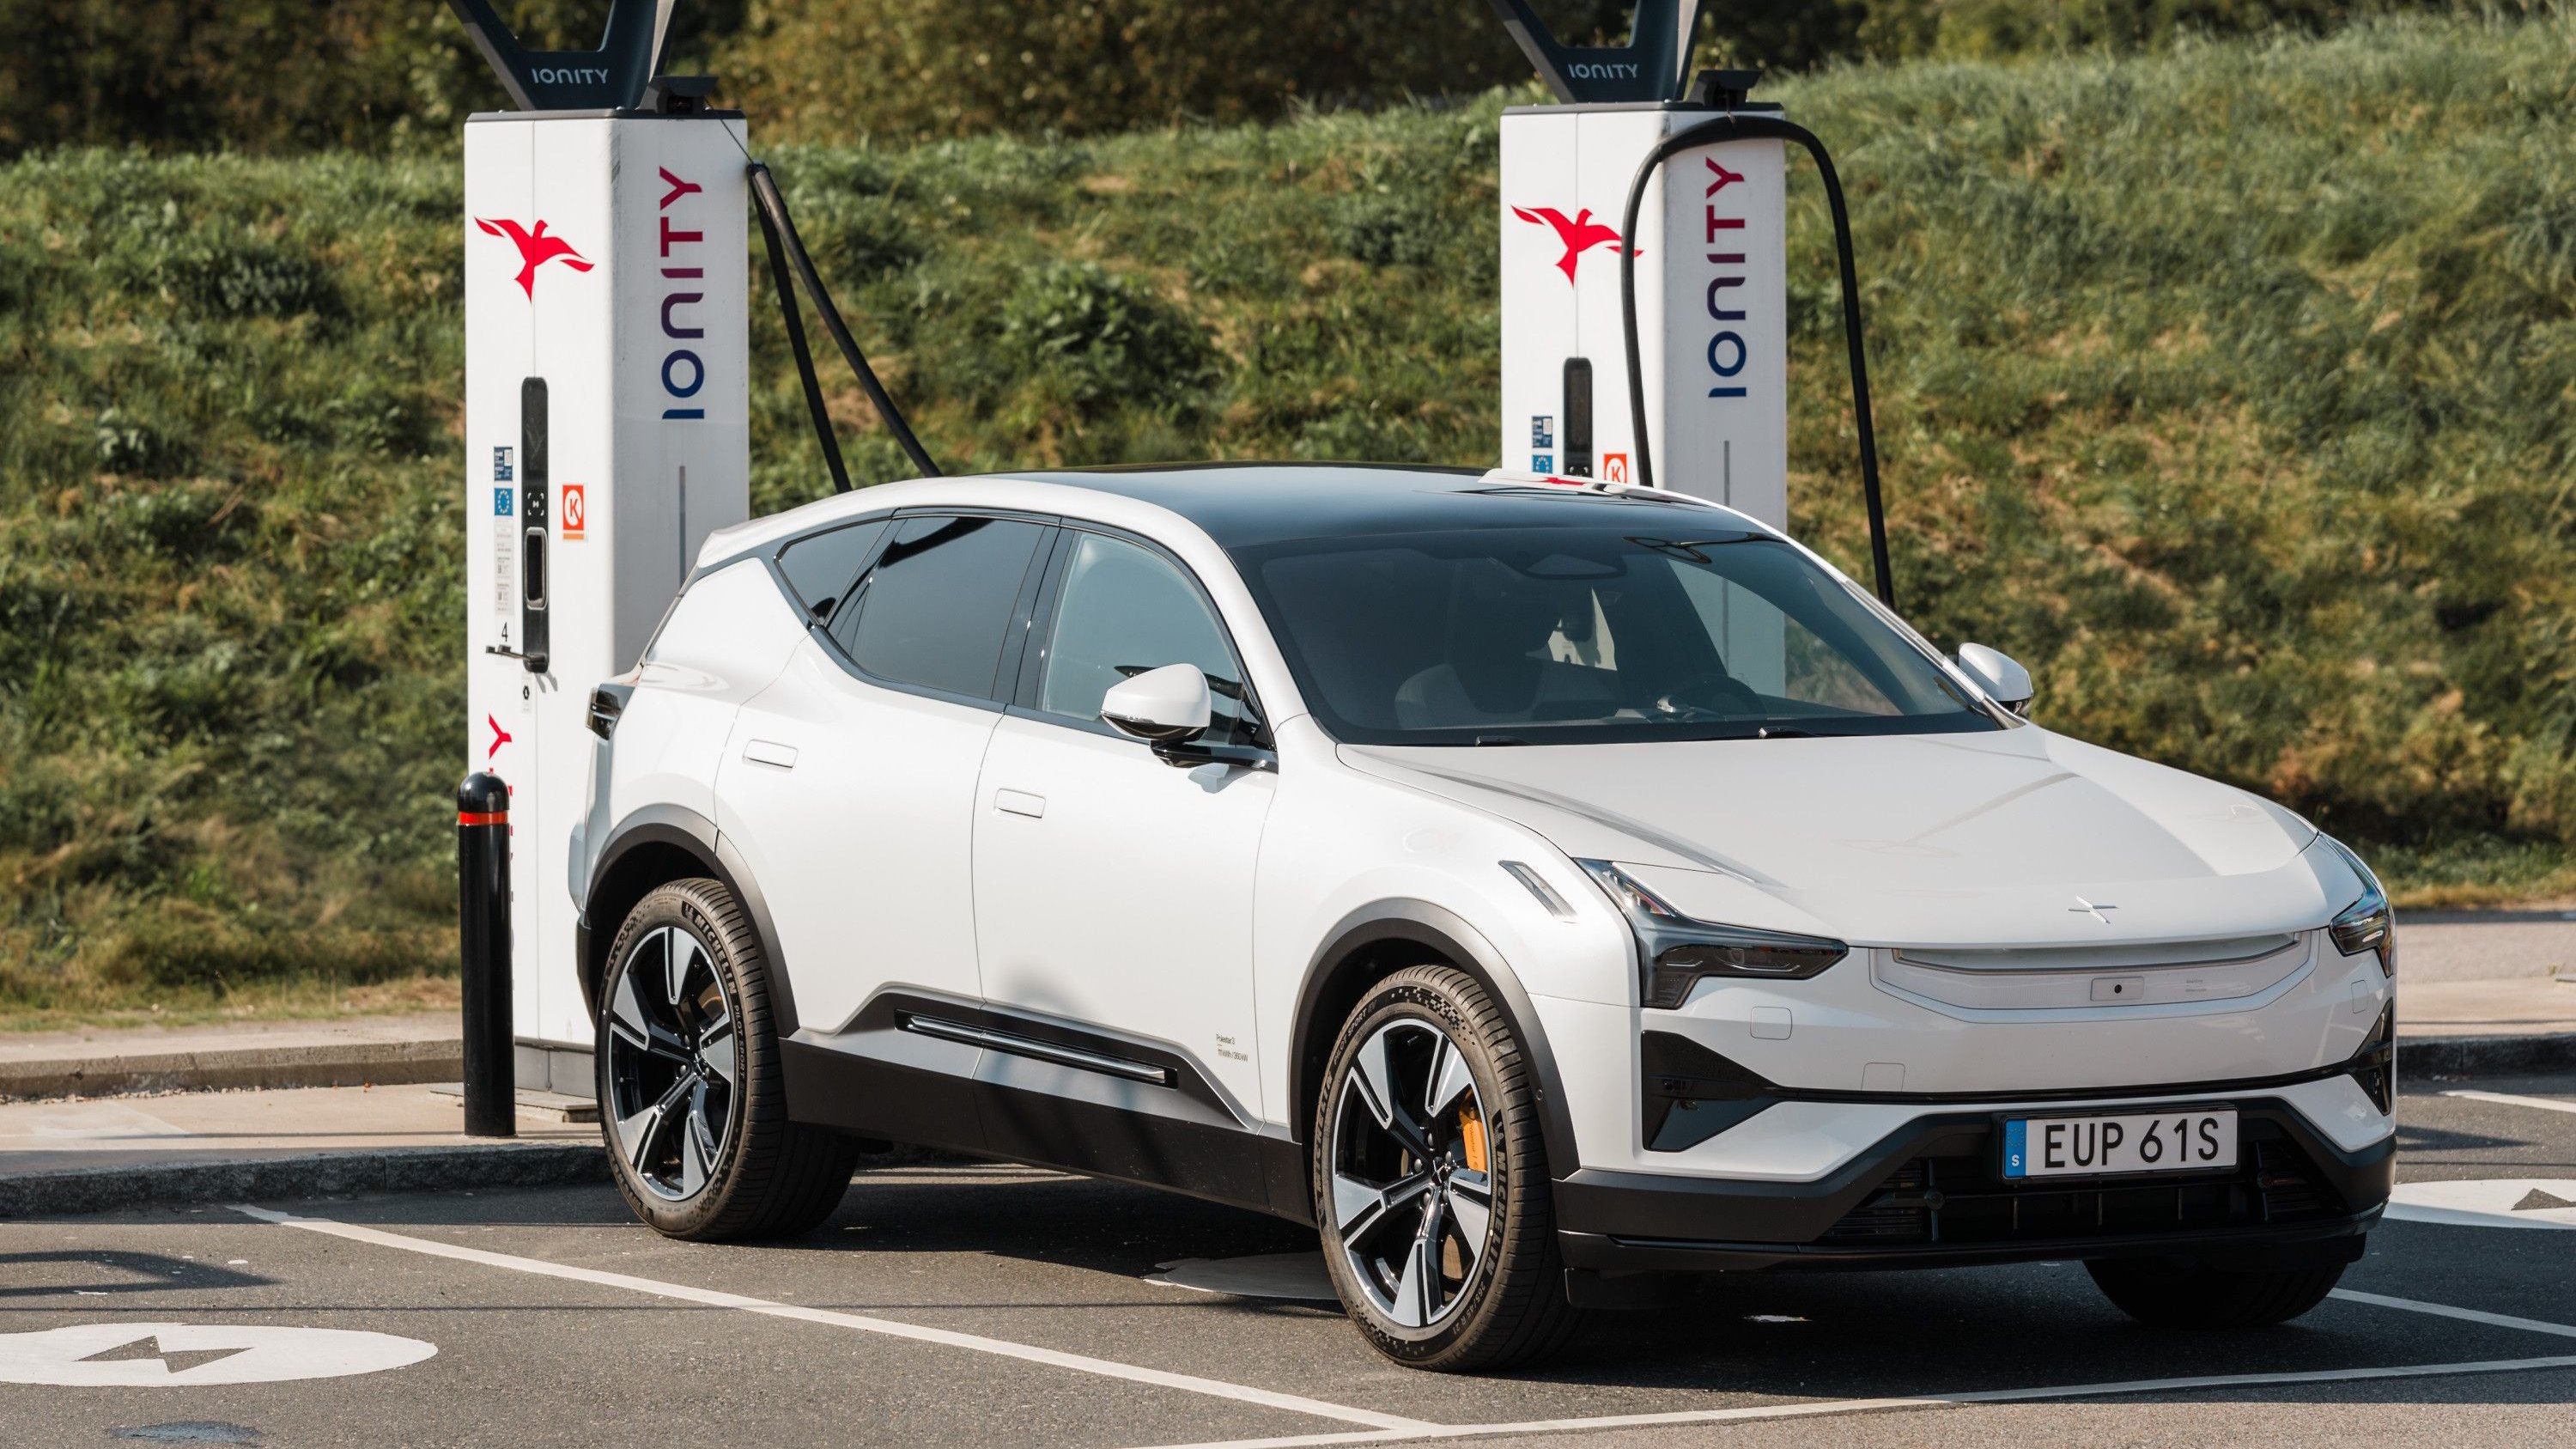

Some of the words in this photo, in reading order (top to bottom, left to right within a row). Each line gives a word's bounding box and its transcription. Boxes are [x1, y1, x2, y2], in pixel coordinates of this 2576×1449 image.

[532, 68, 609, 84] IONITY
[1568, 63, 1638, 79] IONITY
[659, 165, 705, 420] IONITY
[1705, 156, 1747, 399] IONITY
[501, 622, 508, 642] 4
[694, 914, 738, 995] MICHELIN
[734, 1005, 744, 1036] PILOT
[2011, 1154, 2020, 1167] S
[2044, 1122, 2124, 1169] EUP
[2139, 1117, 2219, 1164] 61S
[1485, 1150, 1508, 1276] MICHELIN
